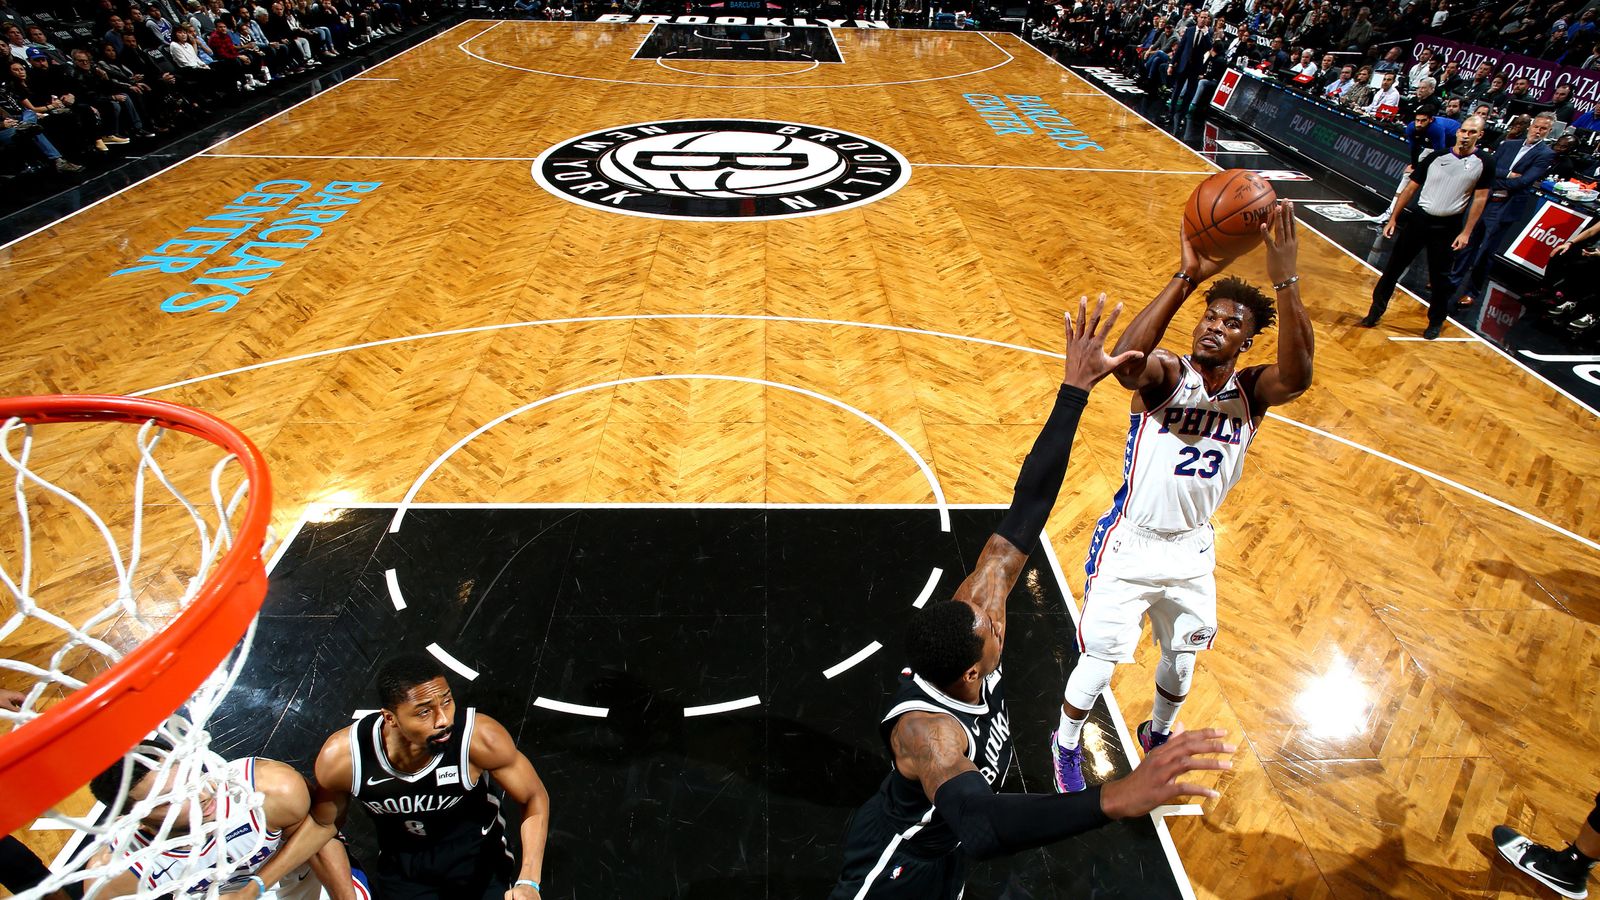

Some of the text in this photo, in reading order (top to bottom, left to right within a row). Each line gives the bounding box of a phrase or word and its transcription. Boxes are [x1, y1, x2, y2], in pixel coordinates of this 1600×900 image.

[595, 14, 890, 28] BROOKLYN
[1413, 42, 1453, 63] QTAR
[1219, 82, 1233, 94] infor
[962, 93, 1035, 135] CENTER
[1004, 94, 1104, 151] BARCLAYS
[1289, 114, 1315, 135] PLAY
[1333, 134, 1364, 160] UNTIL
[1363, 147, 1389, 170] YOU
[553, 125, 669, 205] NEW YORK
[776, 126, 892, 210] BROOKLYN
[109, 179, 312, 277] CENTER
[1529, 223, 1565, 248] infor
[160, 181, 384, 313] BARCLAYS
[1158, 408, 1243, 445] PHILA
[1174, 446, 1224, 479] 23
[438, 771, 456, 780] infor
[404, 820, 427, 836] 8
